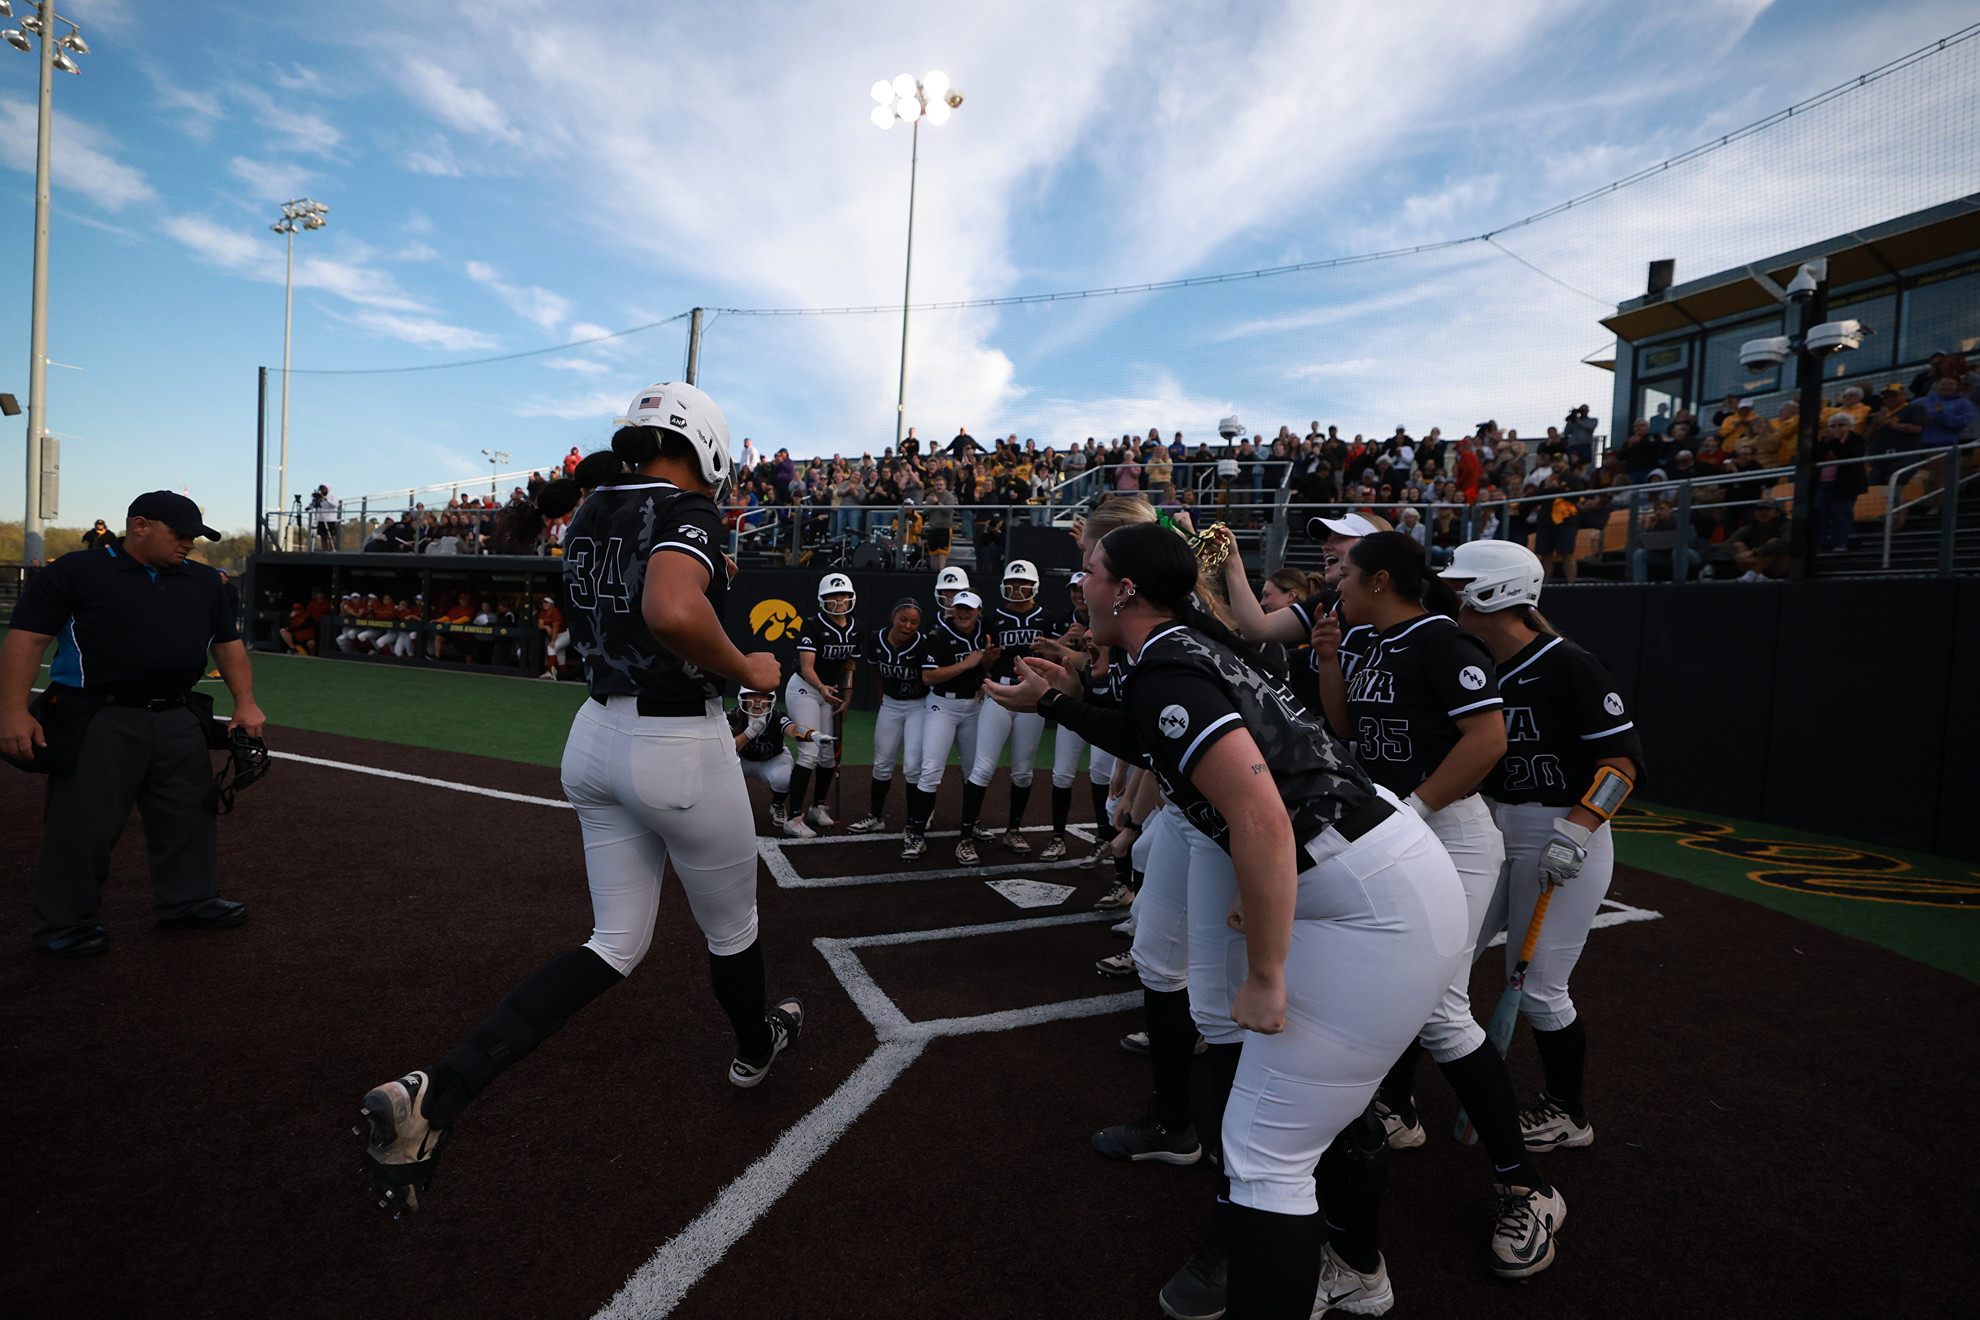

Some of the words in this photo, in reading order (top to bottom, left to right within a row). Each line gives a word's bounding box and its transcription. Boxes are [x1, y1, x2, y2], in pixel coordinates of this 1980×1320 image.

[568, 536, 630, 613] 34
[823, 644, 856, 660] IOW
[879, 660, 920, 680] OWA
[1463, 669, 1483, 687] ANF
[1347, 668, 1396, 704] WA
[1160, 715, 1186, 729] ANF
[1358, 716, 1413, 762] 35
[1503, 753, 1567, 791] 20
